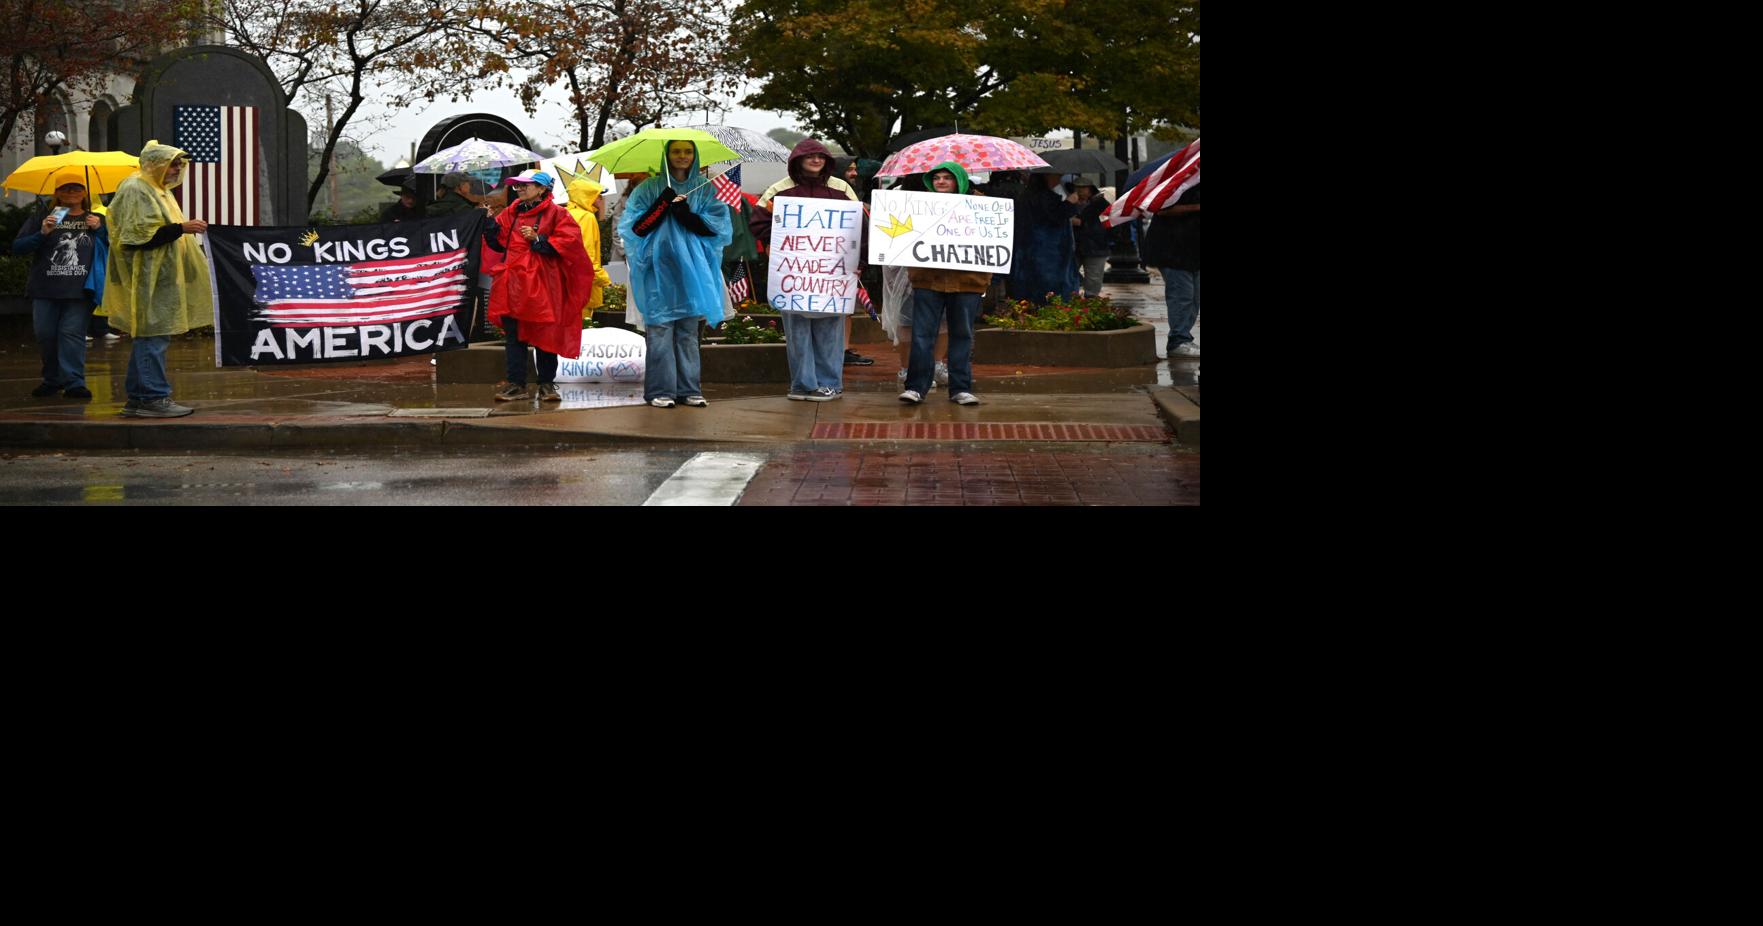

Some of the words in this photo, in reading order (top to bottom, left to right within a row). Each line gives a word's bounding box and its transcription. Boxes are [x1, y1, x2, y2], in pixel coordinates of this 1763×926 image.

[1029, 138, 1062, 149] JESUS
[965, 199, 990, 212] NONE
[992, 201, 1003, 212] OF
[782, 204, 857, 229] HATE
[948, 211, 974, 224] ARE
[974, 212, 996, 225] FREE
[996, 212, 1009, 225] IF
[936, 224, 961, 237] ONE
[964, 225, 976, 236] OF
[243, 242, 292, 264] NO
[313, 237, 411, 263] KINGS
[430, 229, 460, 253] IN
[780, 235, 848, 254] NEVER
[912, 240, 1011, 267] CHAINED
[777, 256, 831, 274] MADE
[829, 256, 847, 275] A
[781, 274, 849, 297] COUNTRY
[772, 294, 852, 313] GREAT
[250, 313, 465, 360] AMERICA
[580, 344, 642, 359] FASCISM
[561, 361, 604, 377] KINGS
